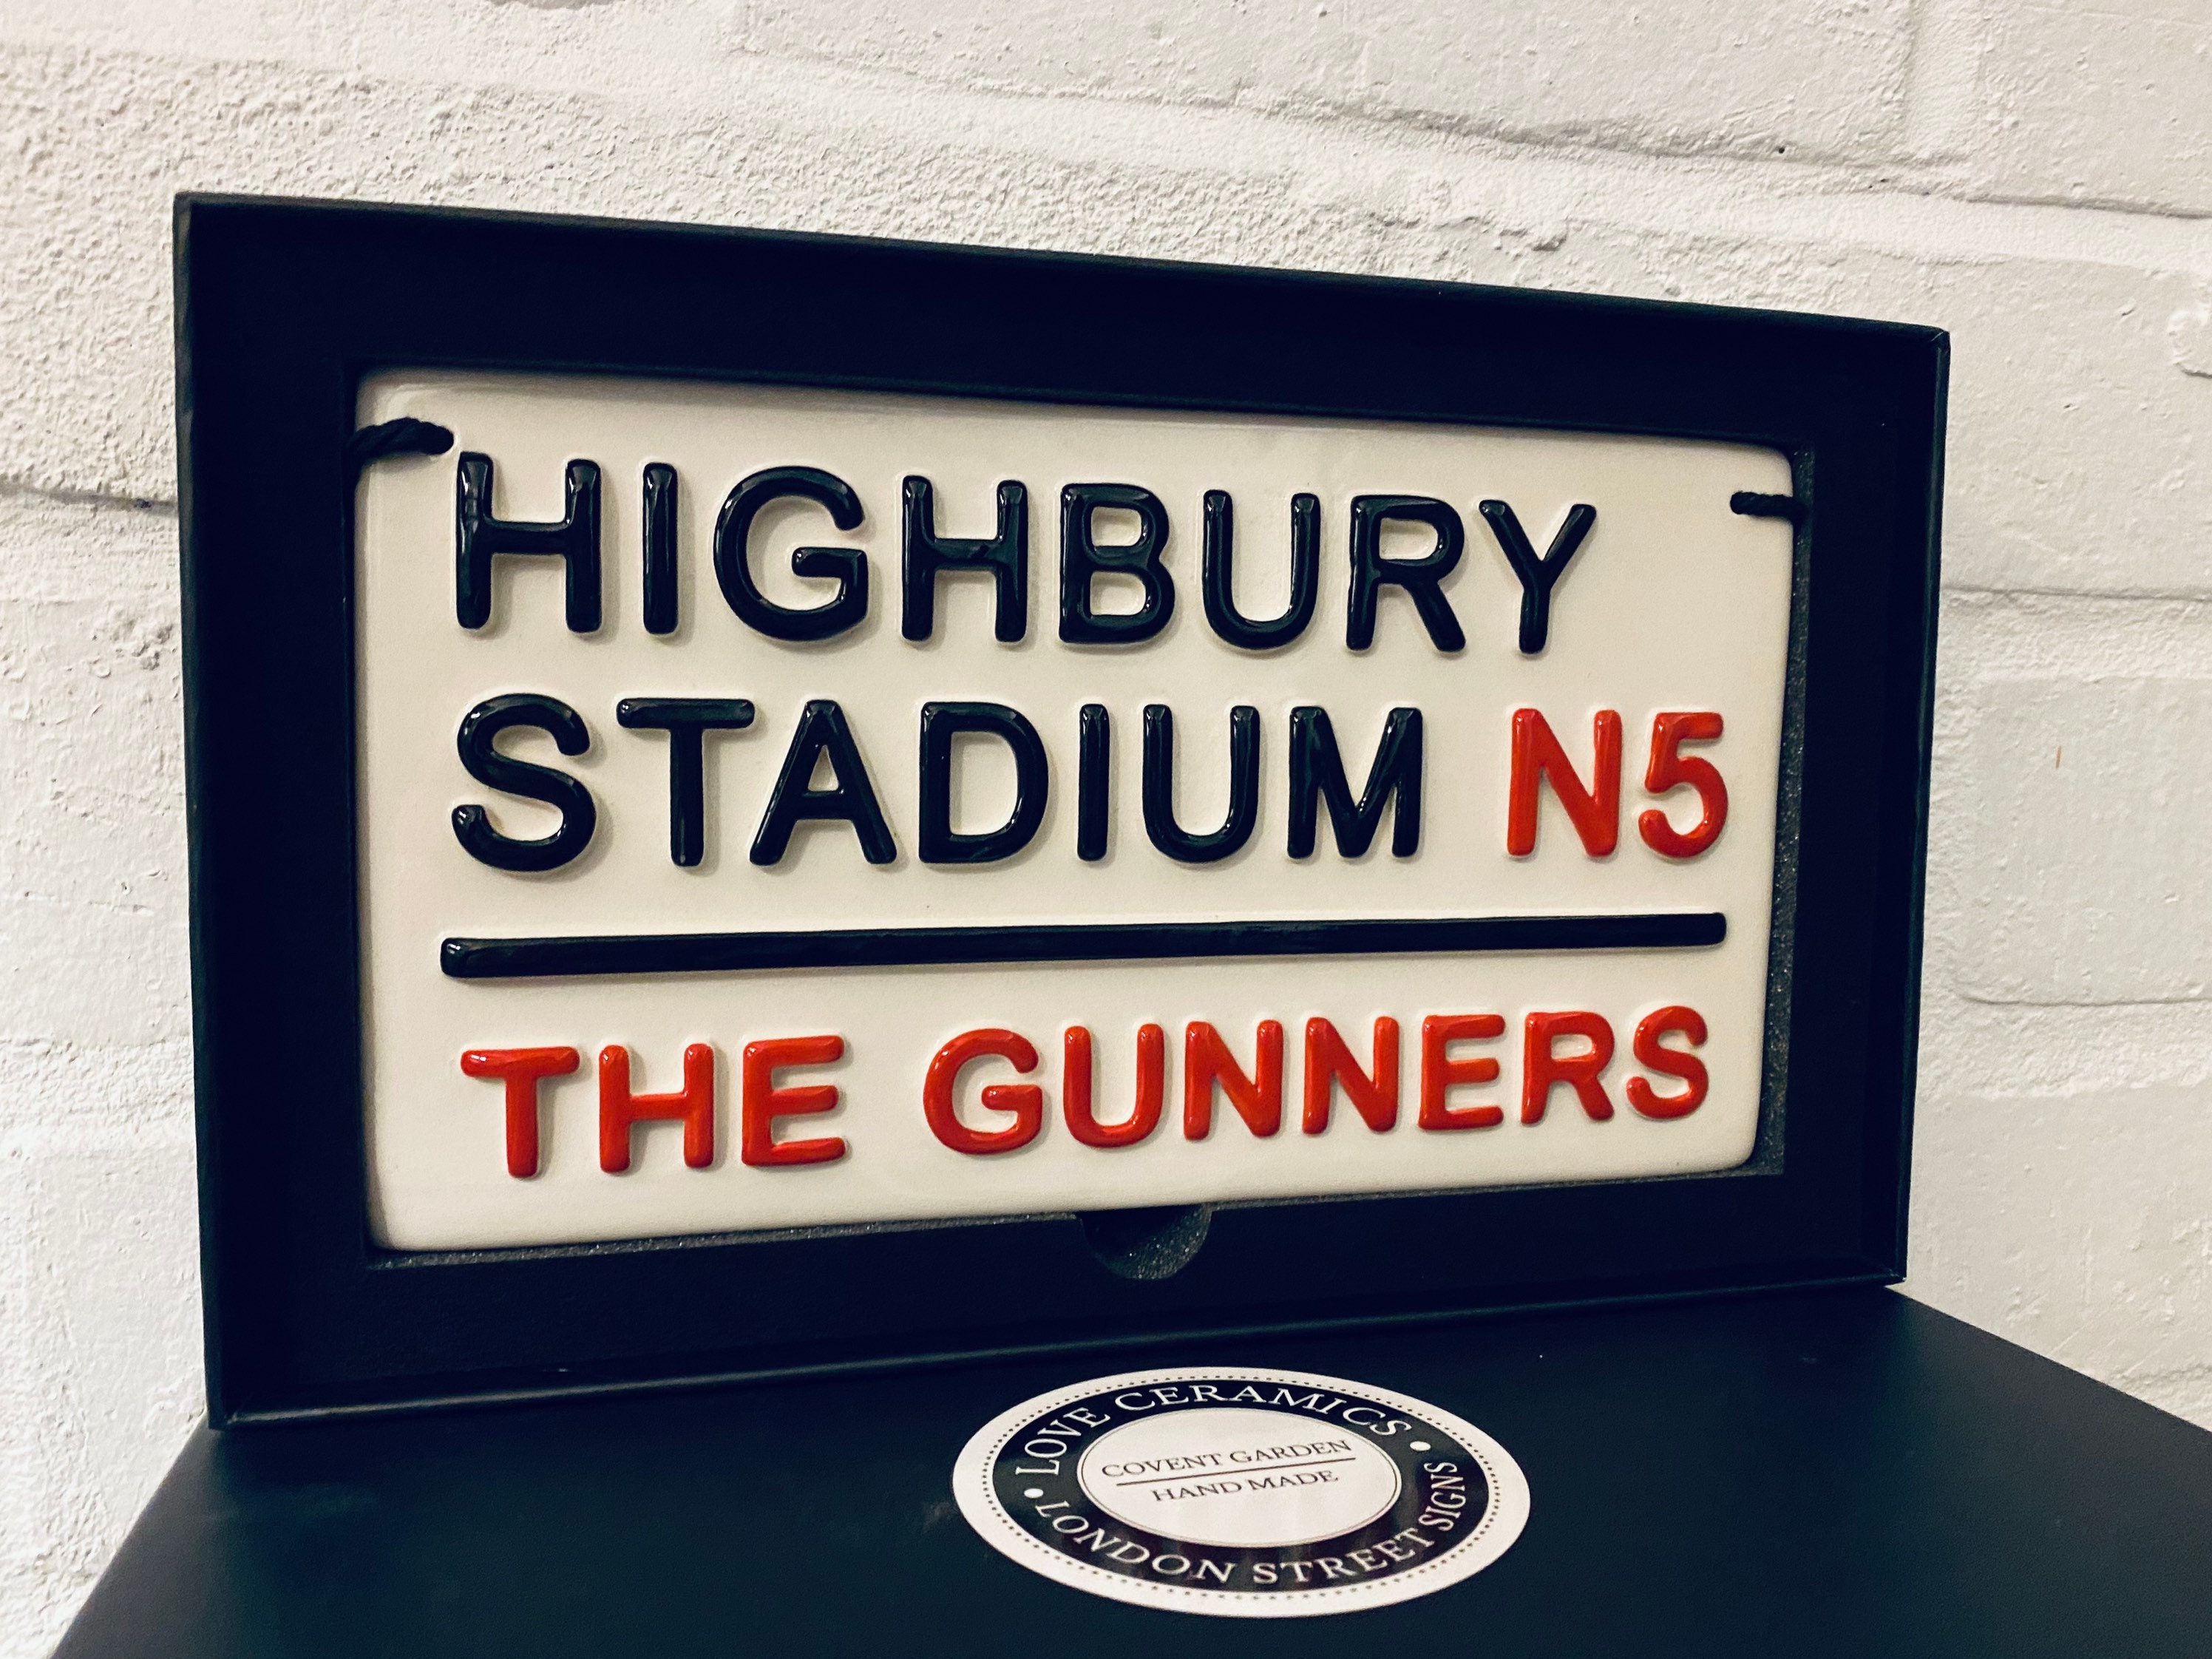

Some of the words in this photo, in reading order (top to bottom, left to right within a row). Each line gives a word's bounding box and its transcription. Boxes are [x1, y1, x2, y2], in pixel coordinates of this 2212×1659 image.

[455, 452, 1597, 654] HIGHBURY
[452, 693, 1423, 872] STADIUM
[1507, 707, 1728, 858] N5
[460, 1035, 847, 1179] THE
[923, 1005, 1709, 1156] GUNNERS
[1015, 1408, 1110, 1477] LOVE
[1115, 1384, 1413, 1438] CERAMICS
[1101, 1451, 1224, 1479] COVENT
[1229, 1439, 1352, 1465] GARDEN
[1150, 1479, 1243, 1503] HAND
[1248, 1469, 1340, 1491] MADE
[1035, 1500, 1238, 1584] LONDON
[1252, 1526, 1436, 1585] STREET
[1417, 1461, 1467, 1532] SIGNS
